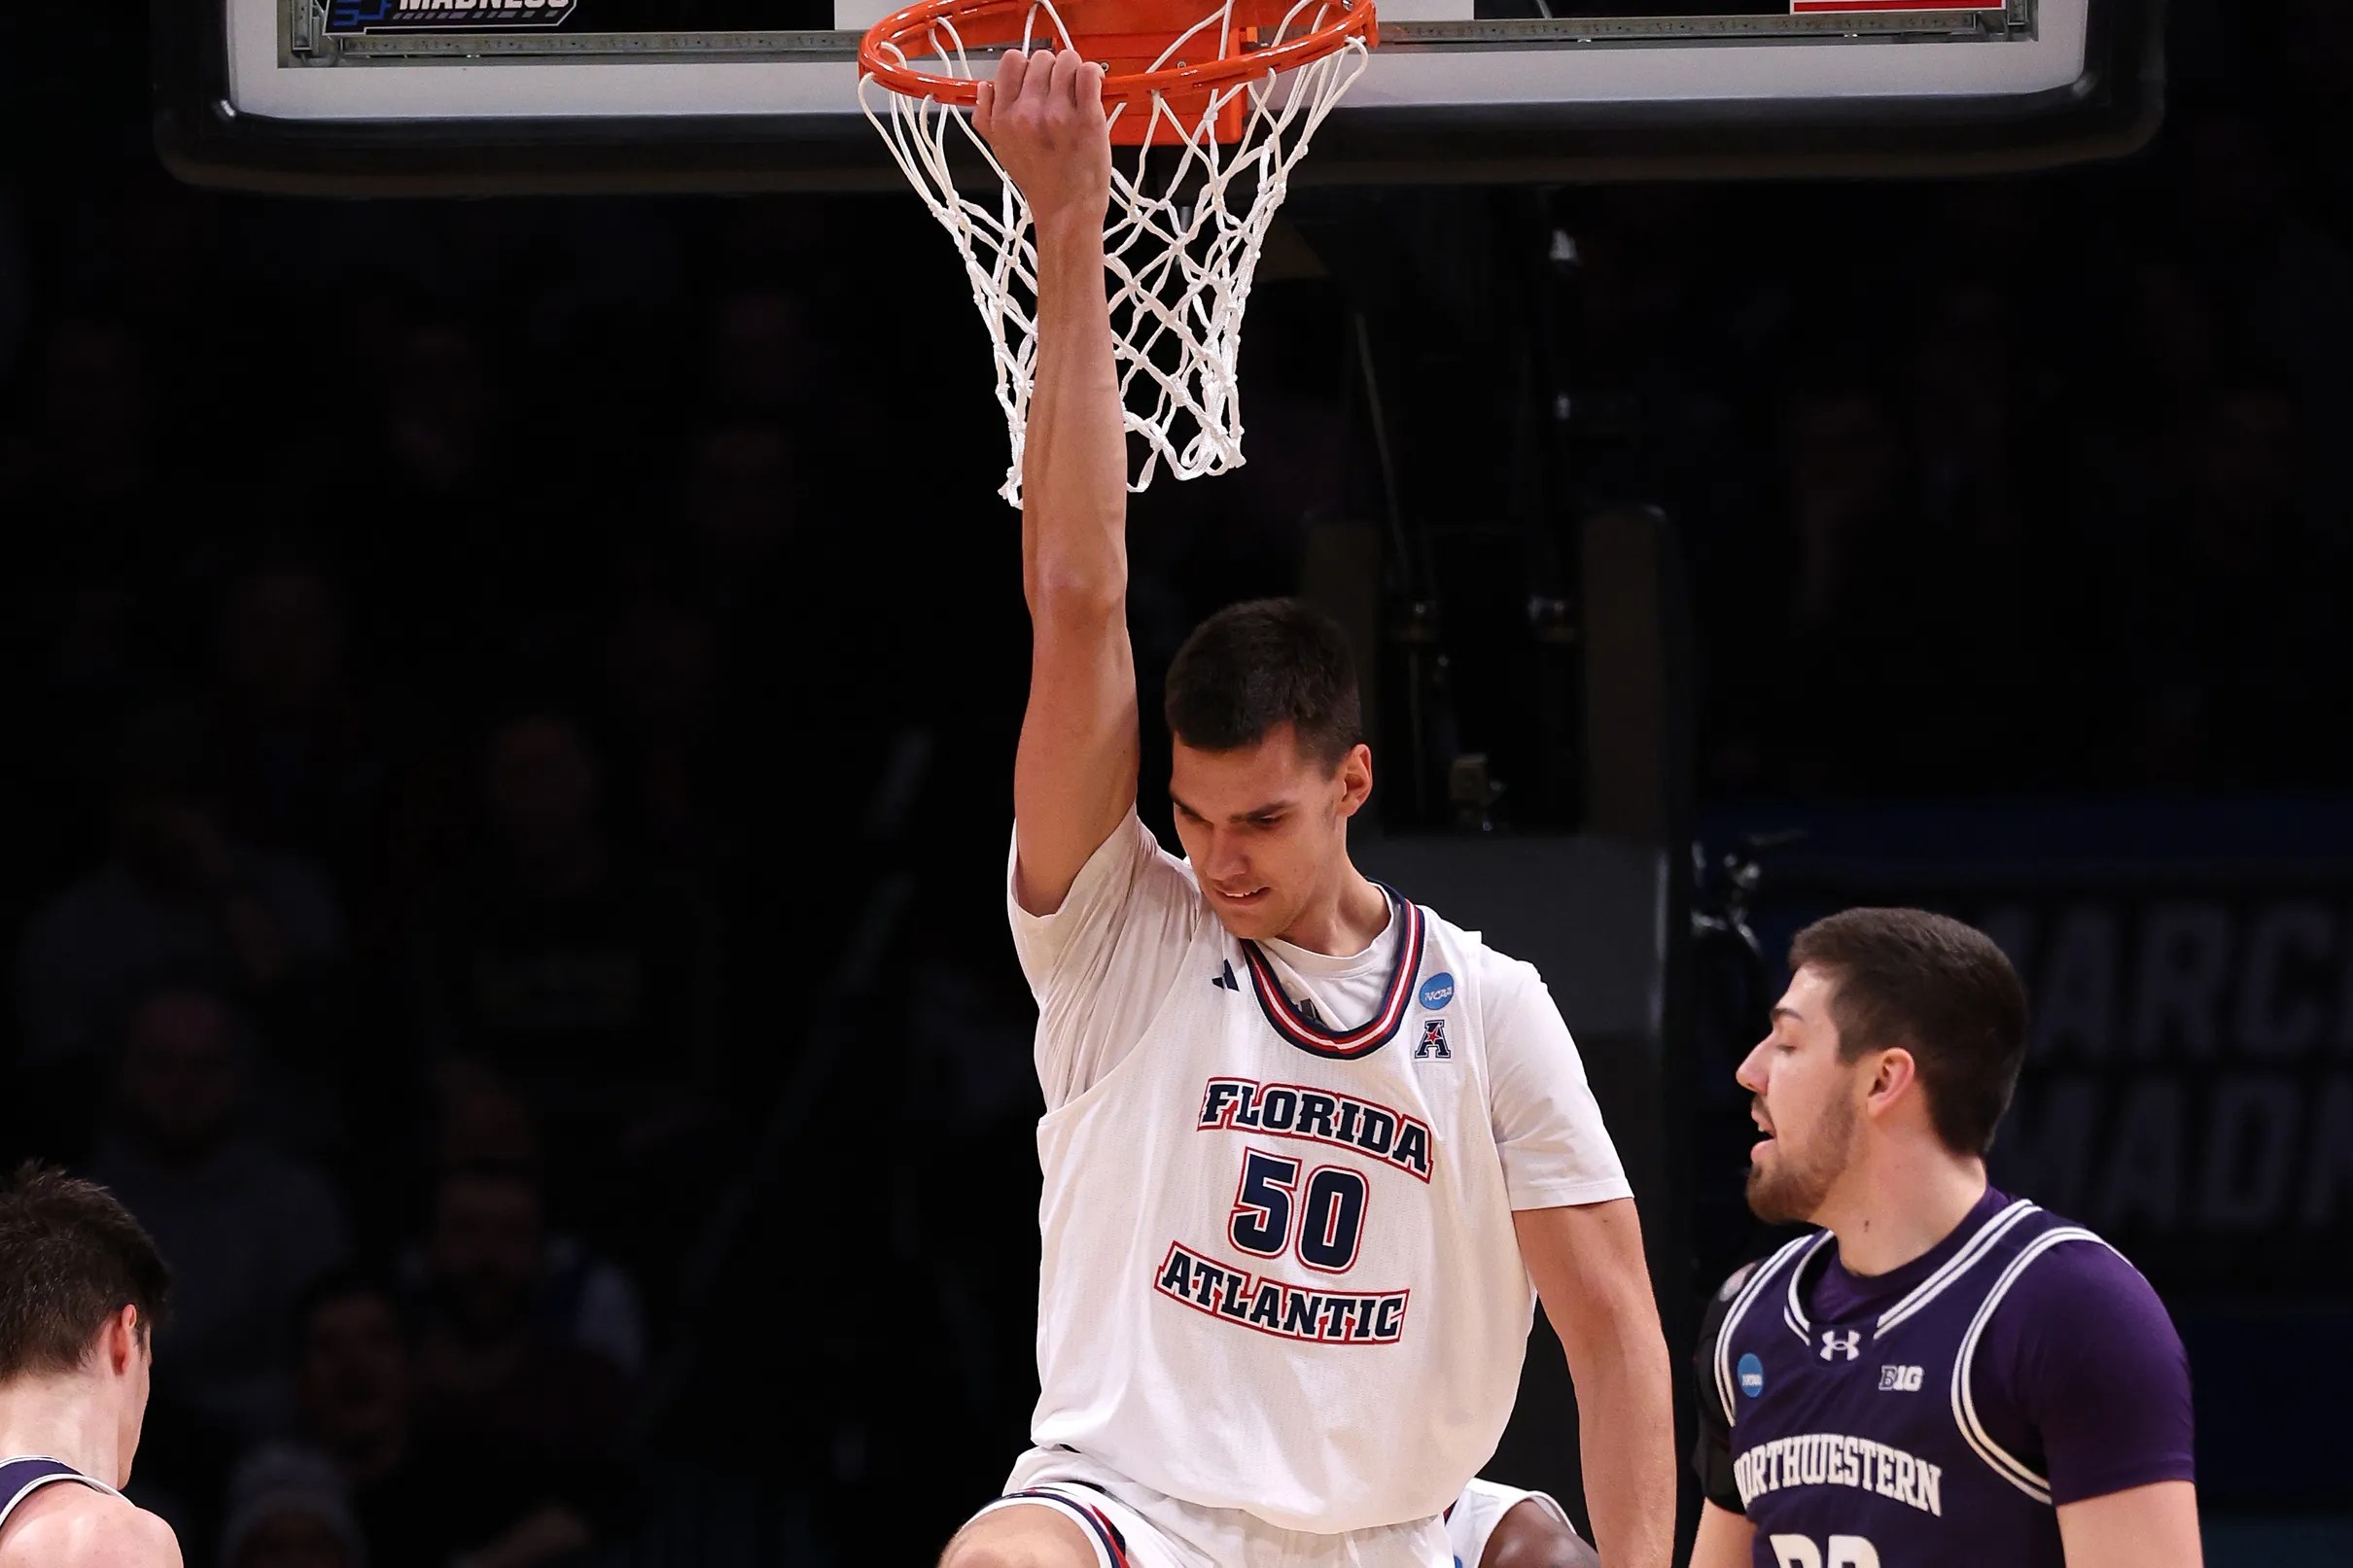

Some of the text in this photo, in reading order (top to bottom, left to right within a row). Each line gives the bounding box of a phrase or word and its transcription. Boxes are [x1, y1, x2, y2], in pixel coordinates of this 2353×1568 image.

[1985, 900, 2353, 1062] ARC
[1197, 1076, 1434, 1184] FLORIDA
[1227, 1146, 1369, 1274] 50
[1154, 1240, 1410, 1344] ATLANTIC
